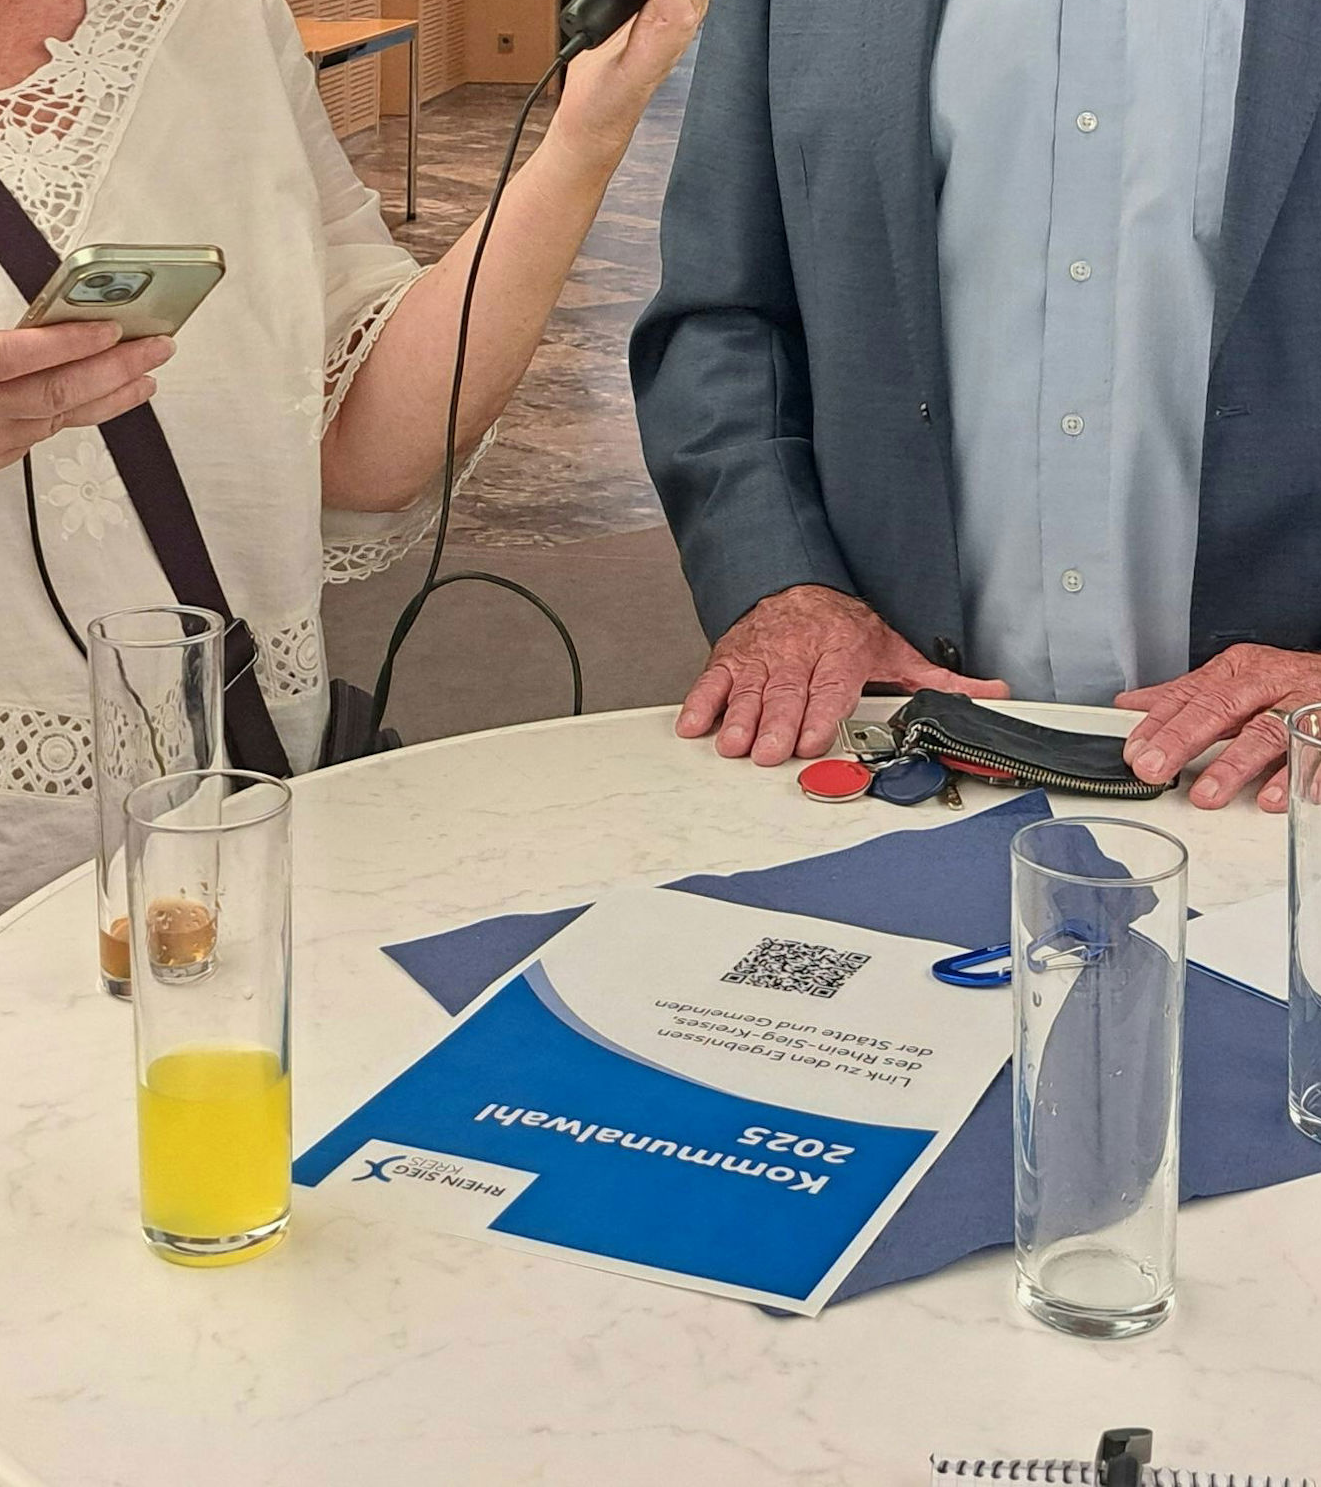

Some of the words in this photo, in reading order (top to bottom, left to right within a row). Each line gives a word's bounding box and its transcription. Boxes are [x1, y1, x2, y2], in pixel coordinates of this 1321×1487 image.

[655, 999, 773, 1027] Gemeinden
[778, 1021, 818, 1035] und
[657, 1028, 786, 1062] Ergebnissen
[673, 1015, 879, 1065] Rhein-Sieg-Kreises,
[822, 1029, 893, 1051] Städte
[896, 1043, 934, 1058] der
[791, 1054, 831, 1070] den
[835, 1063, 862, 1075] zu
[883, 1055, 923, 1072] des
[865, 1069, 912, 1088] Link
[474, 1103, 831, 1195] Kommunalwahl
[736, 1126, 856, 1164] 2025
[392, 1164, 439, 1182] SIEG
[410, 1156, 464, 1175] KREIS
[441, 1175, 506, 1197] RHEIN
